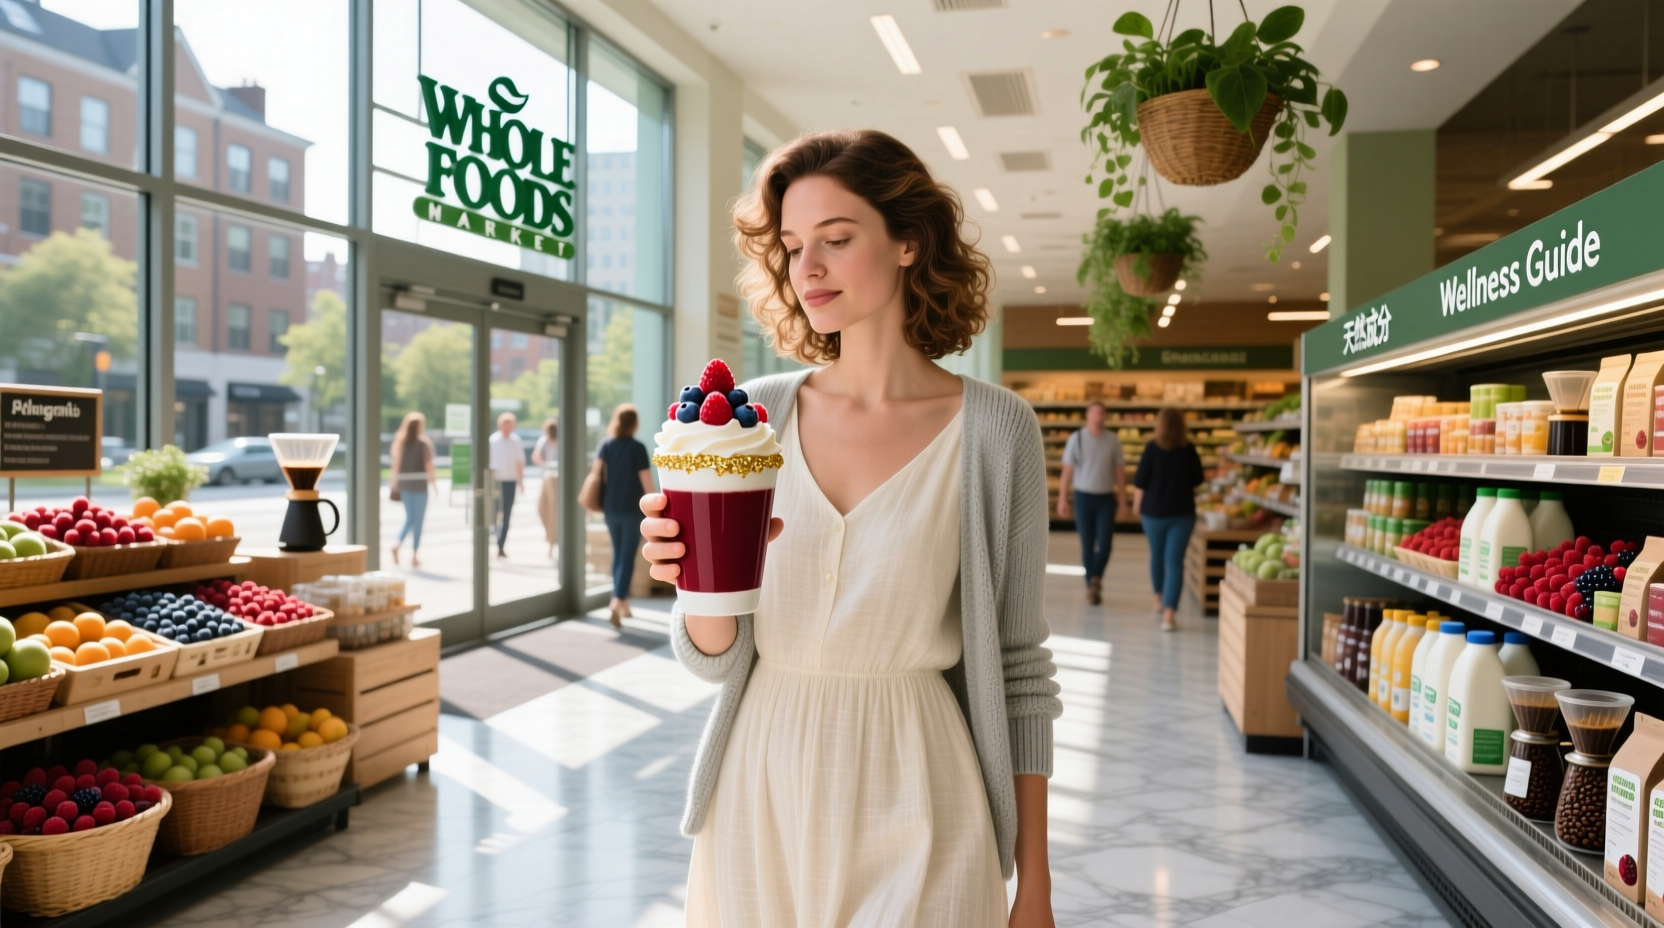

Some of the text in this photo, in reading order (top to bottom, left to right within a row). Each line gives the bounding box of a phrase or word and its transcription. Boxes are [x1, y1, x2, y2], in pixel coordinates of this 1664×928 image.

[417, 74, 576, 190] WHOLE
[425, 141, 574, 238] FOODS
[428, 201, 566, 257] MARKET
[1440, 219, 1601, 317] Wellness Guide
